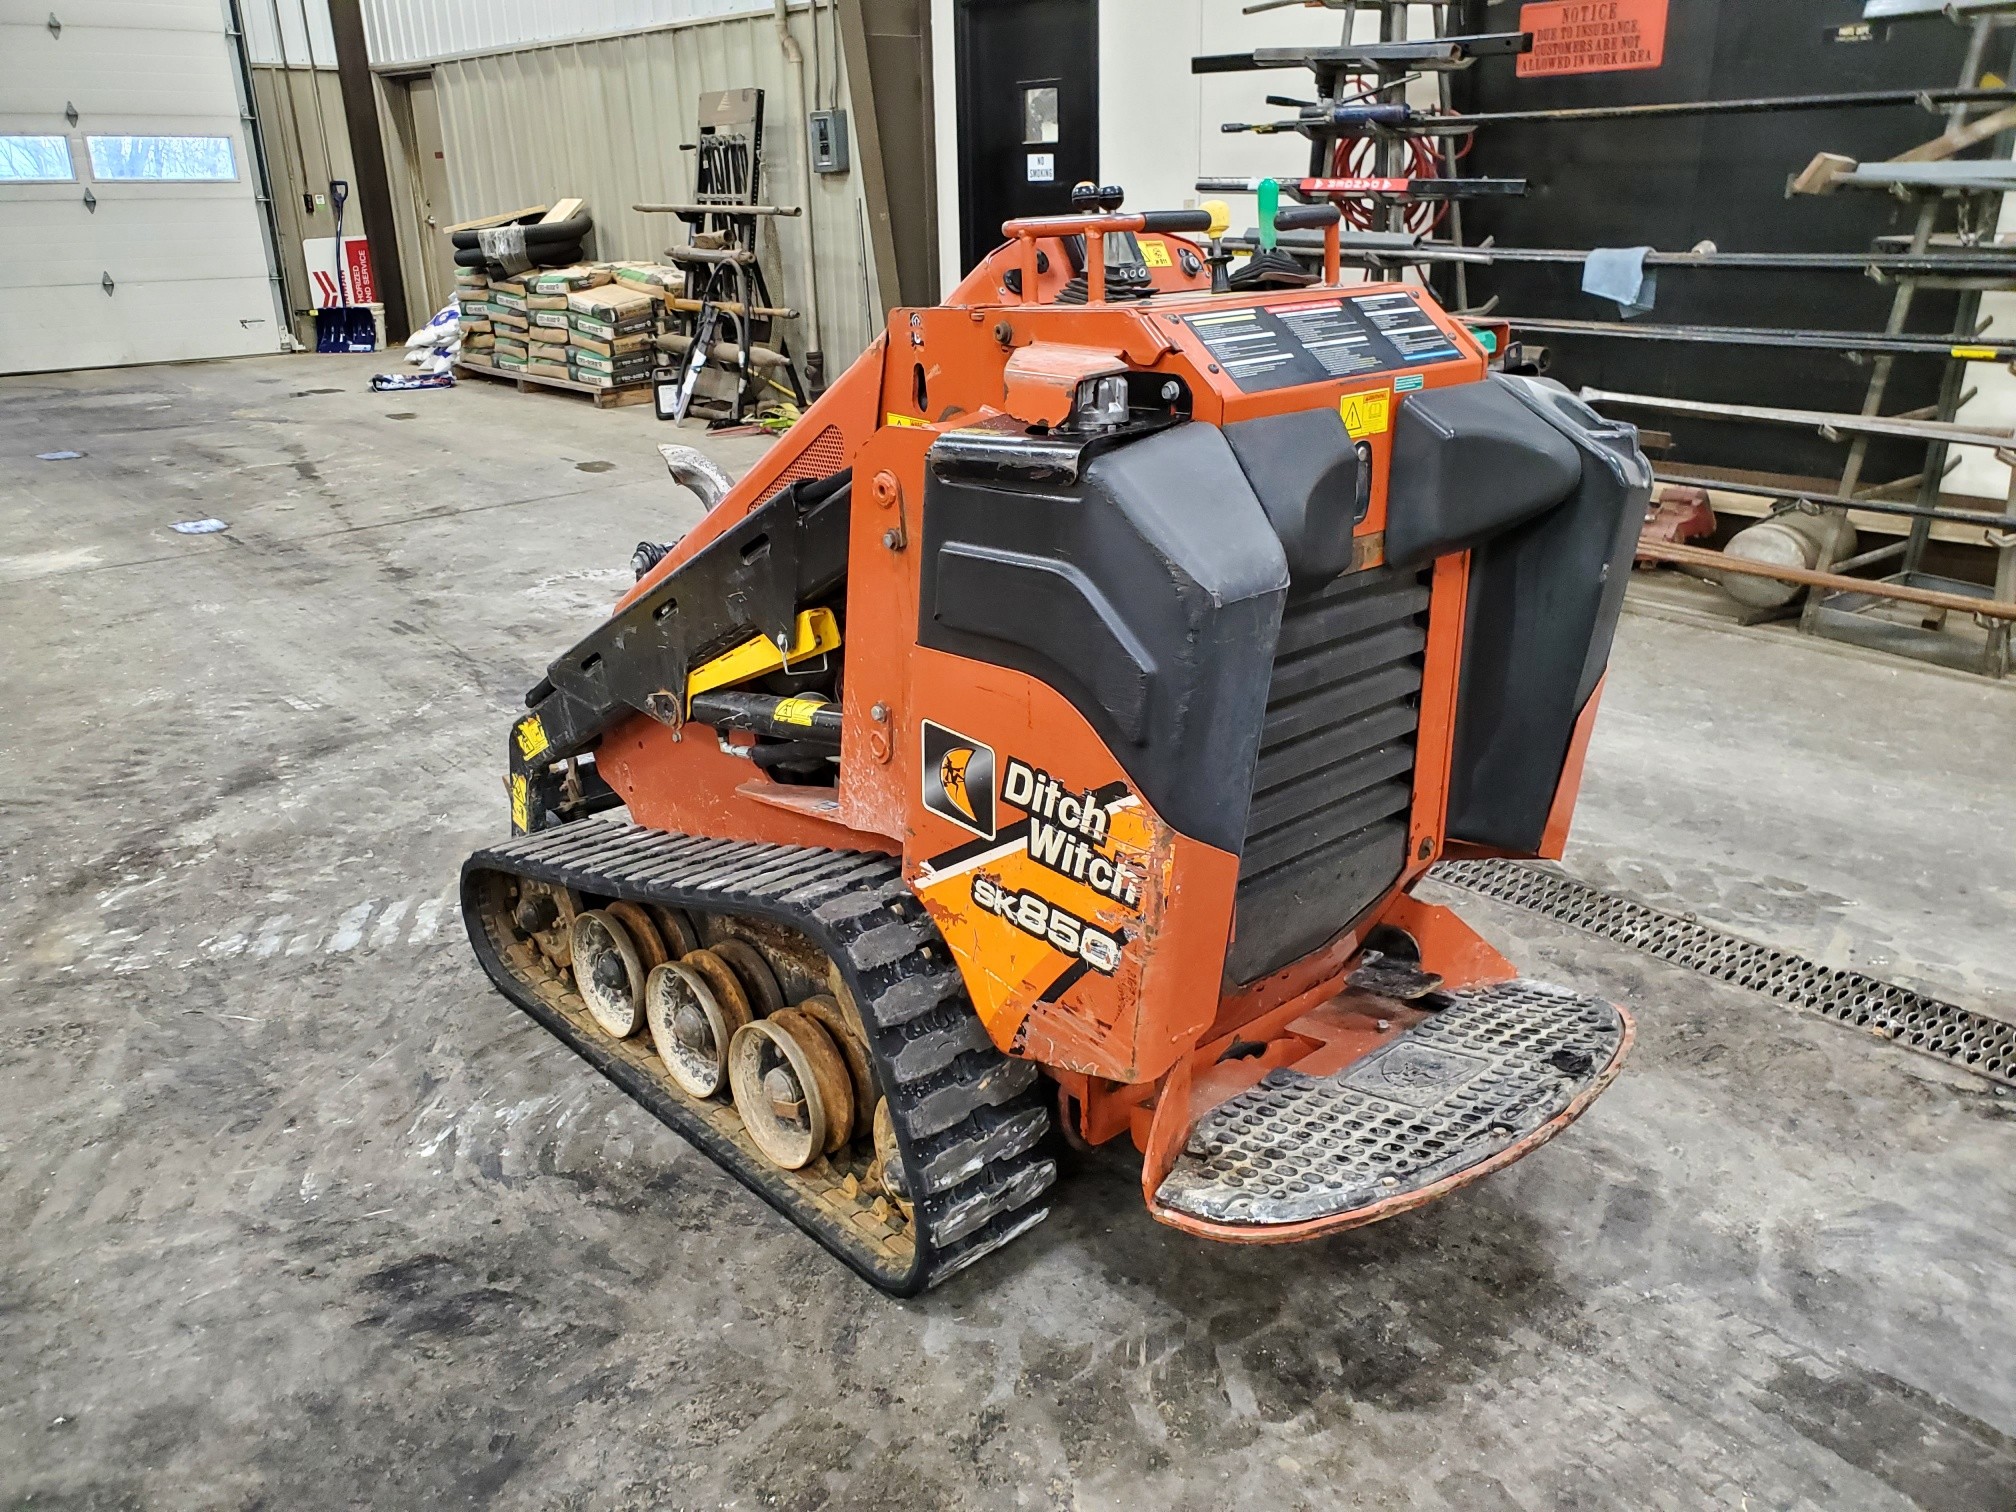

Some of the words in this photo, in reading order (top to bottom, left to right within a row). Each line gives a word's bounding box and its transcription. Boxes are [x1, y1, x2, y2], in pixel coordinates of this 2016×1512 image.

[1562, 3, 1617, 23] NOTICE
[1537, 28, 1558, 41] DUE
[1561, 26, 1572, 38] TO
[1534, 40, 1593, 56] CUSTOMERS
[1596, 37, 1617, 51] ARE
[1621, 36, 1640, 49] NOT
[1522, 56, 1571, 71] ALLOWED
[1573, 54, 1584, 67] IN
[1587, 52, 1617, 66] WORK
[1621, 50, 1651, 63] AREA
[1037, 157, 1044, 165] NO
[1030, 169, 1052, 178] SMOKING
[358, 249, 369, 285] SERVICE
[1004, 762, 1107, 842] Ditch
[1030, 817, 1138, 904] Witch
